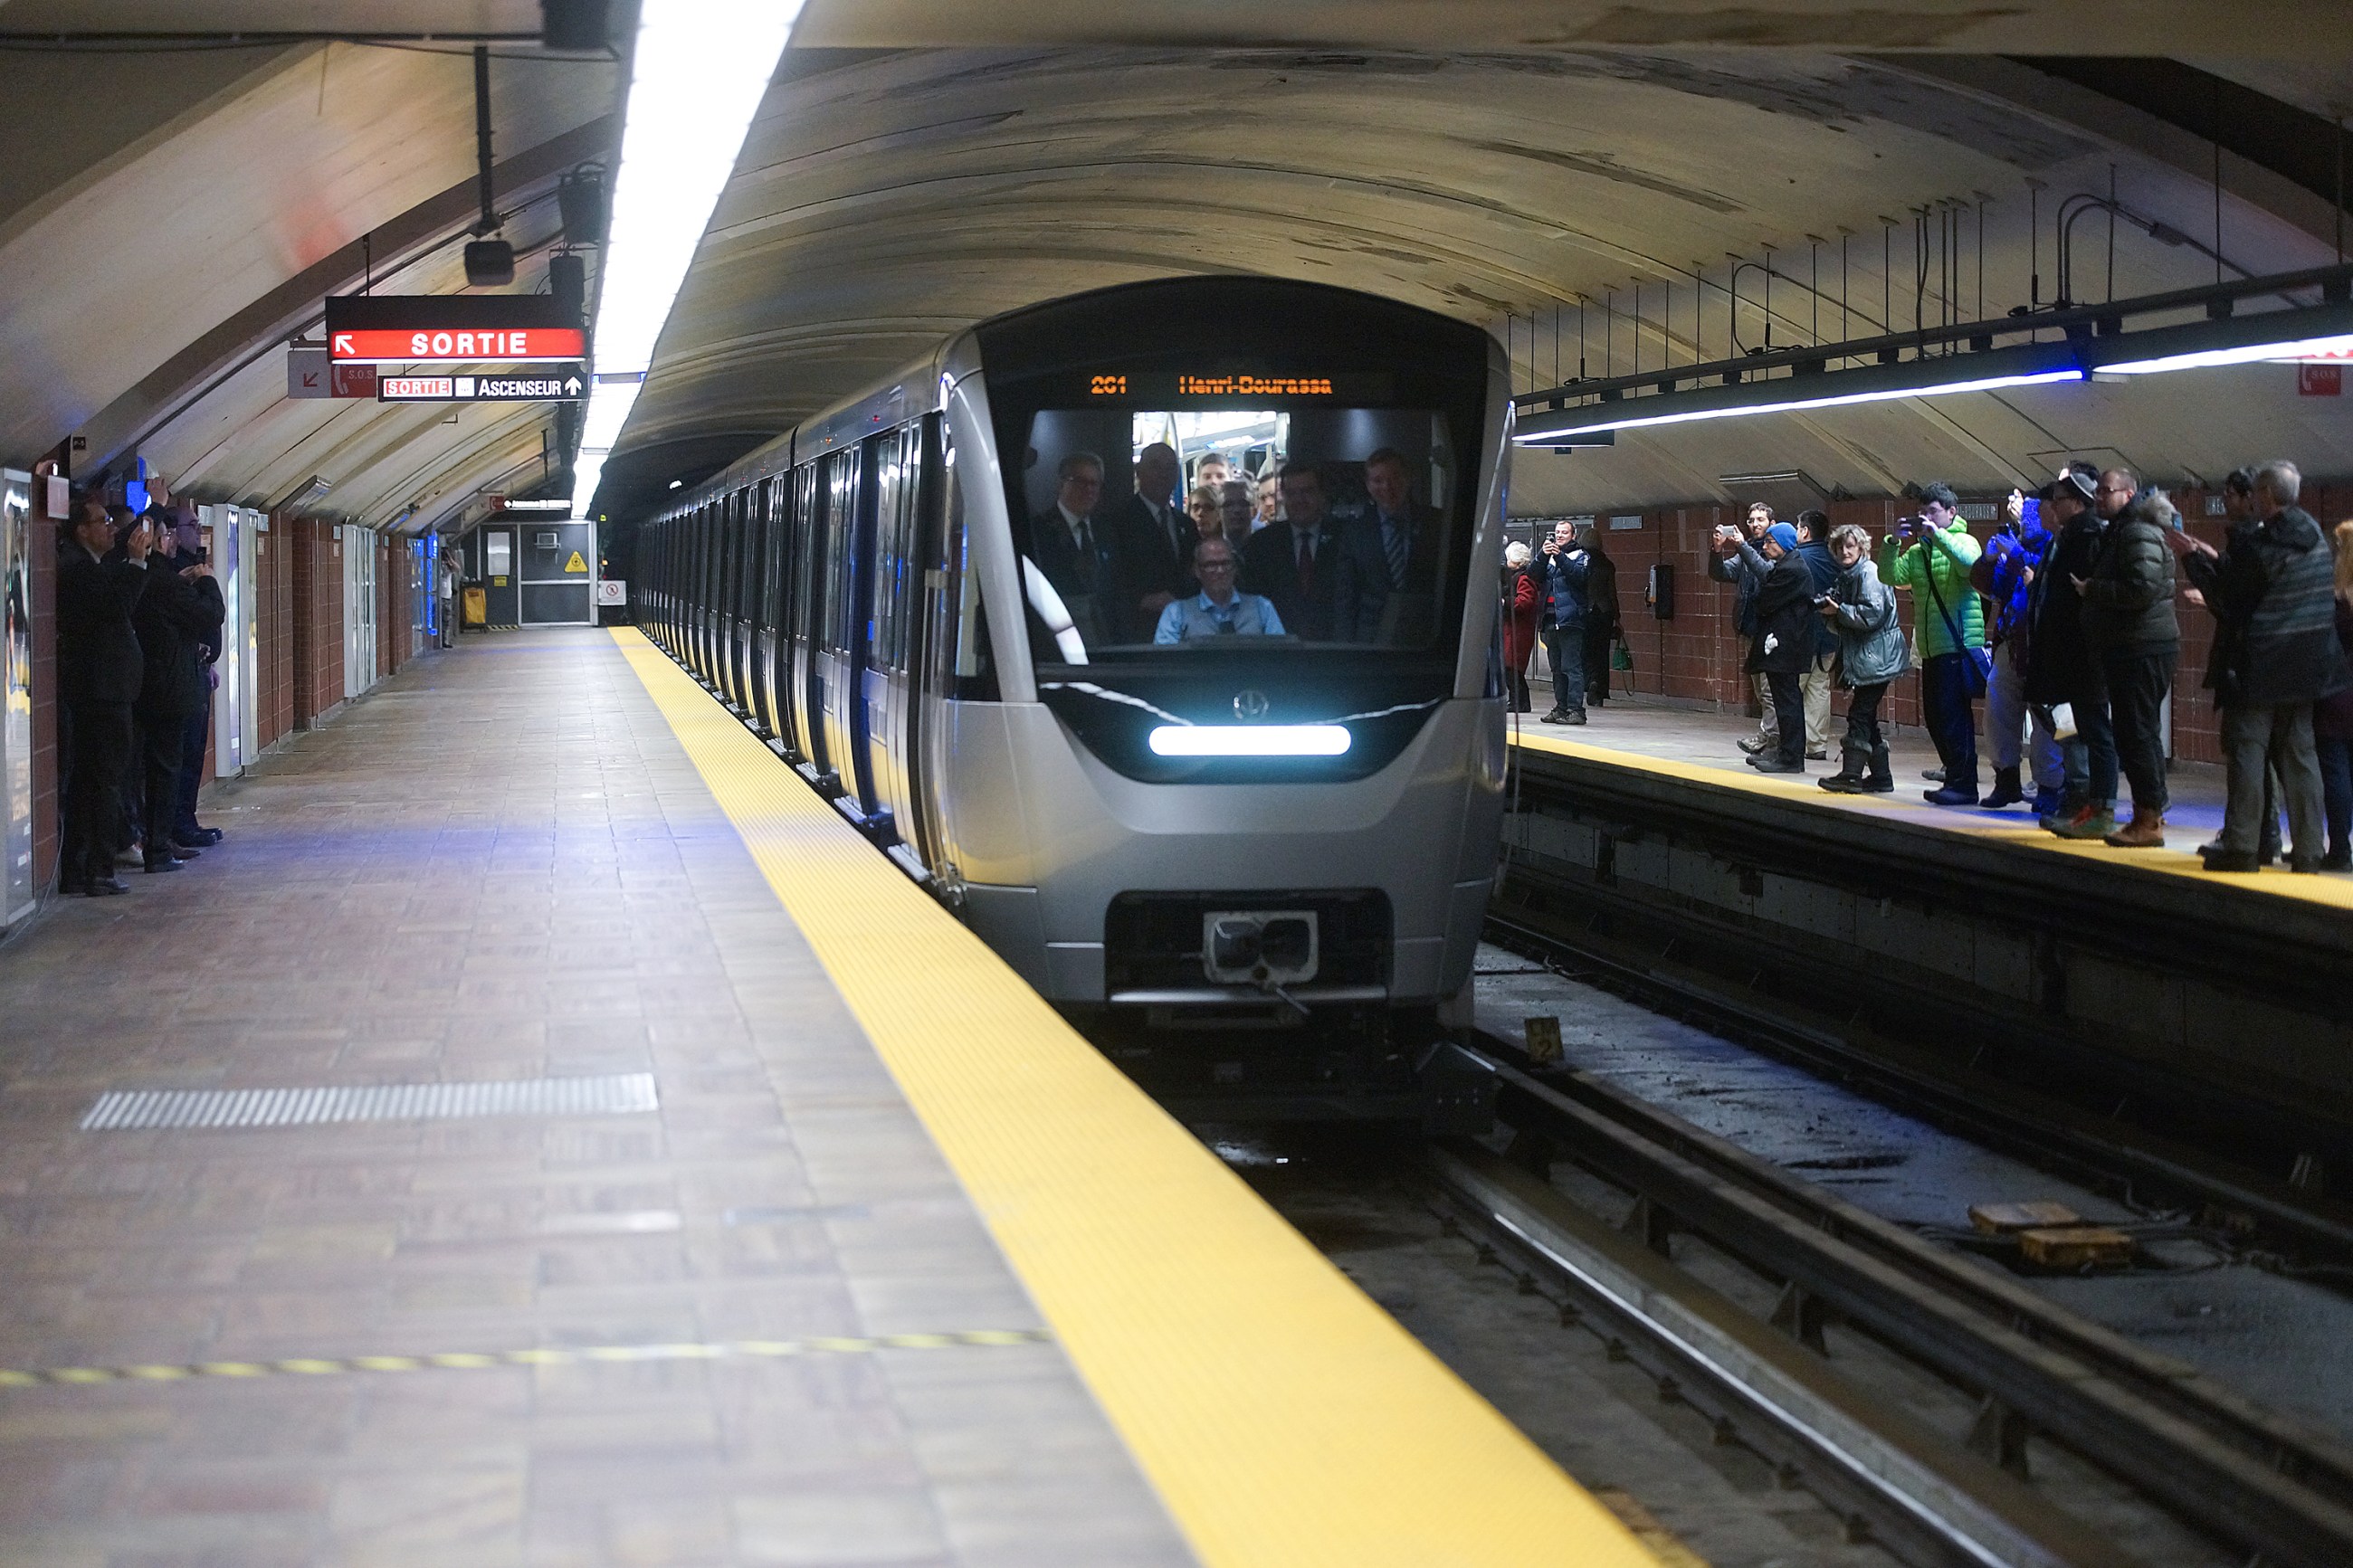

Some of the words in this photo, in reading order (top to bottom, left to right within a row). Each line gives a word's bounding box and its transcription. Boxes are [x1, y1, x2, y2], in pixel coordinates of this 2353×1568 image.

[411, 332, 527, 356] SORTIE
[348, 369, 376, 380] S.O.S.
[387, 380, 450, 394] SORTIE
[478, 378, 562, 396] ASCENSEUR
[1091, 375, 1127, 394] 201
[1179, 375, 1332, 394] Henri-Bourassa
